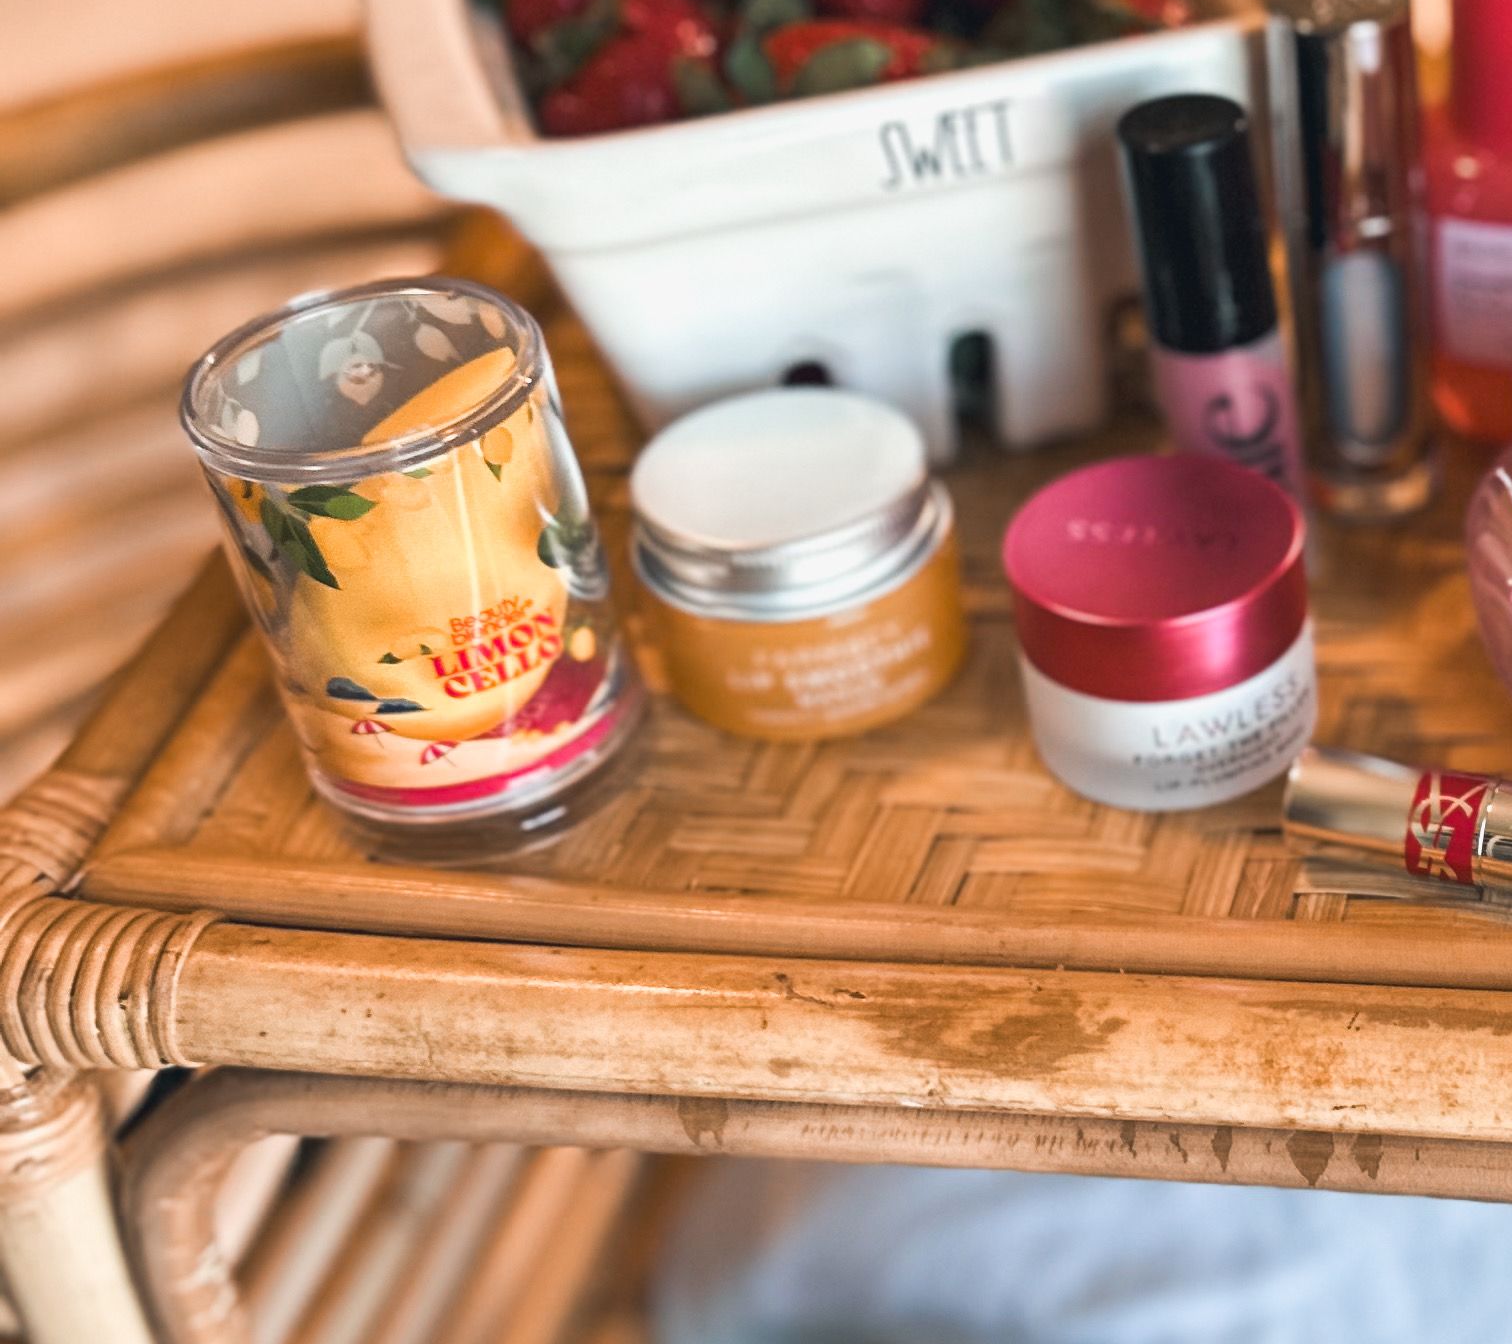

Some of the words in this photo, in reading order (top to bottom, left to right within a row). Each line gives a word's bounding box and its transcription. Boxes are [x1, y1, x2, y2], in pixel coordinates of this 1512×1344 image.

[878, 98, 1014, 191] SWEET
[429, 607, 555, 680] LIMON
[443, 634, 563, 699] CELLO
[1151, 670, 1298, 749] LAWLESS
